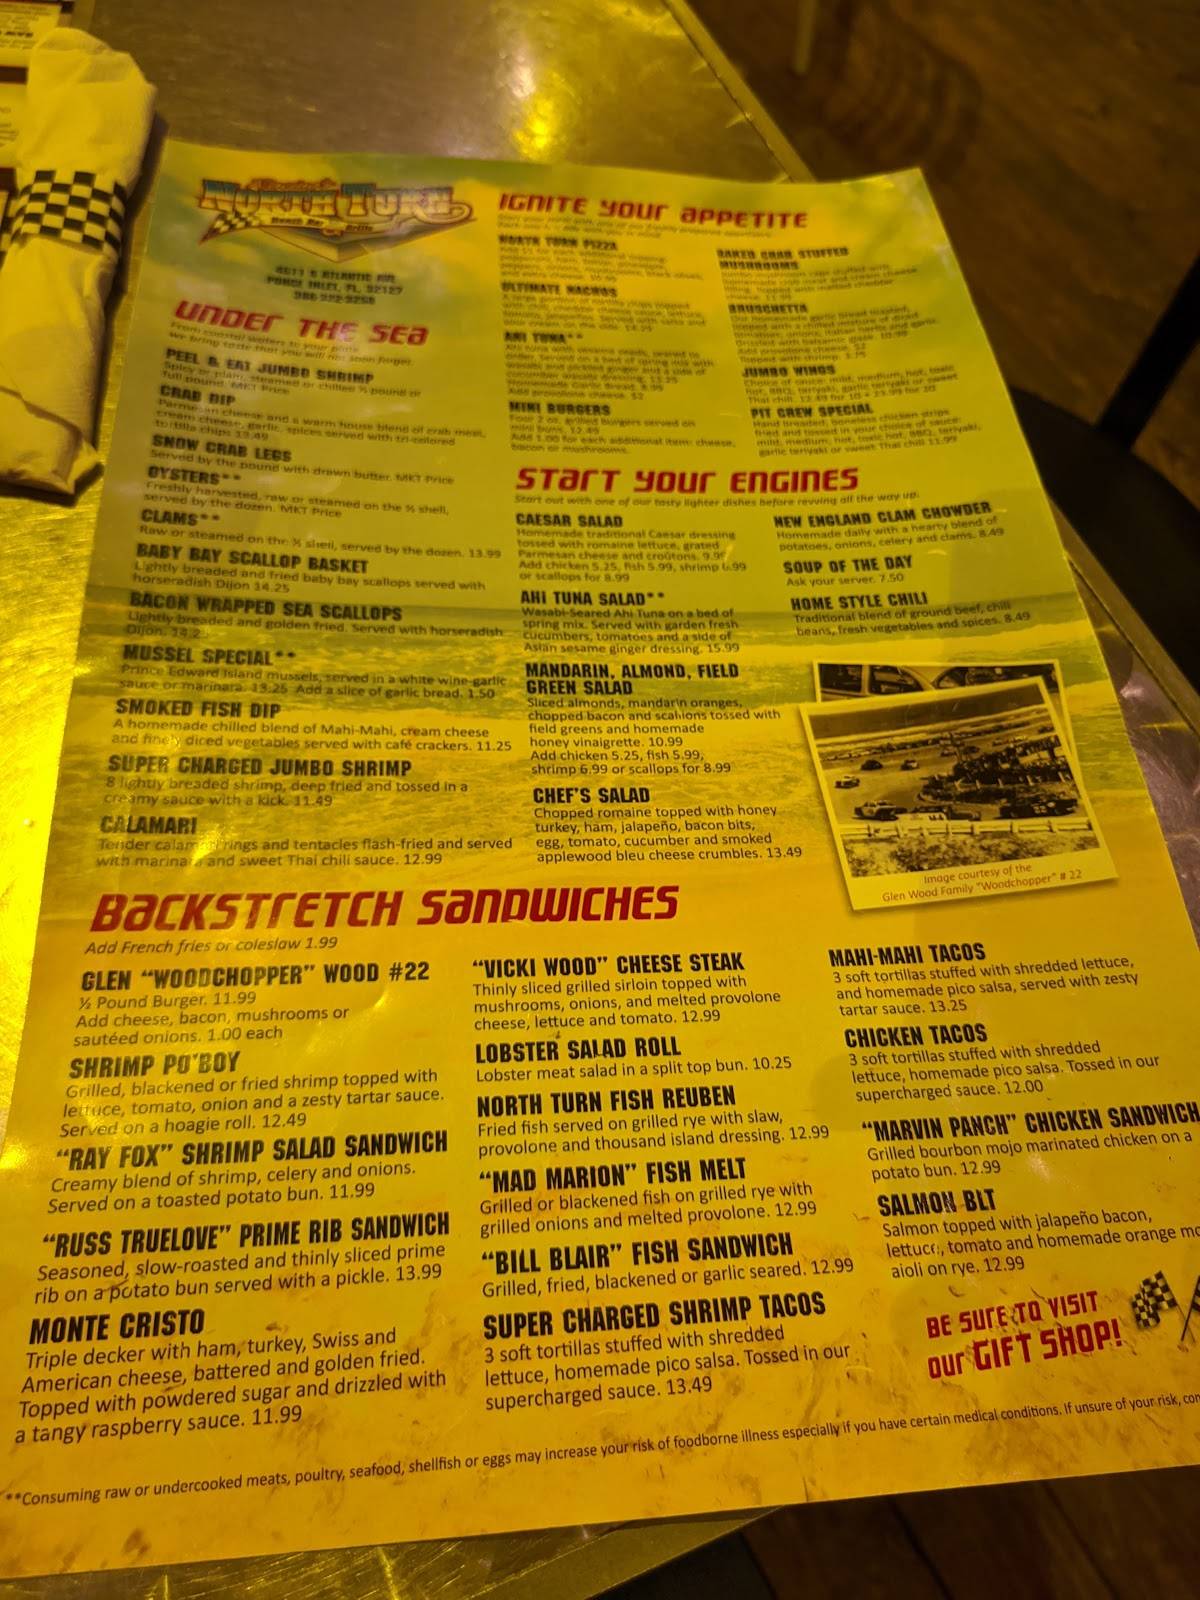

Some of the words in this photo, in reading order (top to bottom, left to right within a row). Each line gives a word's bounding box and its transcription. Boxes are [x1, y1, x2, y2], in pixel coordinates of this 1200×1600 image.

[299, 318, 358, 339] THE
[115, 698, 193, 716] SMOKED
[201, 700, 242, 717] FISH
[250, 702, 281, 718] DIP
[528, 722, 557, 734] field
[559, 725, 603, 736] greens
[605, 724, 630, 734] and
[632, 723, 705, 734] homemade
[529, 736, 570, 749] honey
[572, 737, 644, 750] vinaigrette.
[648, 736, 683, 747] 10.99
[532, 787, 591, 804] CHEF'S
[598, 787, 650, 803] SALAD
[536, 850, 612, 864] applewood
[615, 849, 645, 861] bleu
[648, 849, 695, 860] cheese
[698, 847, 763, 860] crumbles.
[766, 846, 802, 858] 13.49
[881, 891, 906, 902] Glen
[907, 887, 938, 899] Wood
[940, 883, 974, 895] Family
[1069, 869, 1082, 880] 22
[923, 874, 956, 884] Image
[957, 869, 1000, 880] courtesy
[1001, 863, 1012, 877] of
[1014, 863, 1032, 873] the
[83, 940, 119, 954] Add
[120, 940, 174, 954] French
[175, 939, 212, 956] fries
[214, 941, 231, 952] or
[234, 938, 301, 951] coleslaw
[304, 936, 338, 949] 1.99
[828, 946, 923, 966] MAHI-MAHI
[928, 942, 986, 962] TACOS
[81, 970, 132, 991] GLEN
[323, 963, 379, 983] WOOD
[388, 961, 429, 981] #22
[474, 1017, 530, 1031] cheese,
[534, 1015, 585, 1028] lettuce
[589, 1012, 616, 1026] and
[619, 1012, 677, 1025] tomato.
[682, 1009, 721, 1023] 12.99
[838, 1005, 878, 1016] tartar
[881, 1003, 926, 1014] sauce.
[929, 998, 967, 1013] 13.25
[475, 1041, 559, 1063] LOBSTER
[567, 1038, 626, 1059] SALAD
[634, 1036, 682, 1057] ROLL
[50, 1177, 118, 1193] Creamy
[122, 1171, 172, 1189] blend
[175, 1170, 195, 1186] of
[198, 1169, 261, 1186] shrimp,
[266, 1166, 317, 1183] celery
[321, 1162, 352, 1179] and
[357, 1161, 416, 1177] onions.
[877, 1191, 957, 1216] SALMON
[962, 1188, 996, 1212] BLT
[631, 1239, 679, 1265] FISH
[687, 1232, 793, 1260] SANDWICH
[482, 1278, 542, 1298] Grilled,
[546, 1275, 590, 1293] fried,
[594, 1269, 677, 1290] blackened
[681, 1271, 698, 1284] or
[703, 1264, 745, 1286] garlic
[749, 1261, 806, 1279] seared.
[810, 1257, 854, 1275] 12.99
[891, 1261, 924, 1278] aioli
[927, 1263, 948, 1276] on
[950, 1261, 980, 1276] rye.
[983, 1255, 1025, 1272] 12.99
[28, 1314, 110, 1344] MONTE
[119, 1309, 205, 1338] CRISTO
[926, 1314, 952, 1339] BE
[1010, 1300, 1042, 1325] TO
[1047, 1290, 1098, 1318] VISIT
[971, 1332, 1032, 1370] GIFT
[1039, 1319, 1122, 1359] SHOP!
[1000, 1403, 1063, 1421] conditions.
[1063, 1401, 1073, 1416] If
[1074, 1401, 1113, 1414] unsure
[1114, 1396, 1126, 1410] of
[1128, 1397, 1155, 1411] your
[1157, 1393, 1181, 1407] risk,
[14, 1429, 26, 1444] a
[32, 1425, 87, 1444] tangy
[91, 1417, 183, 1439] raspberry
[187, 1413, 245, 1431] sauce.
[252, 1404, 302, 1425] 11.99
[105, 1487, 131, 1499] raw
[134, 1485, 150, 1497] or
[153, 1474, 242, 1495] undercooked
[246, 1473, 291, 1487] meats,
[294, 1467, 345, 1486] poultry,
[349, 1461, 405, 1478] seafood,
